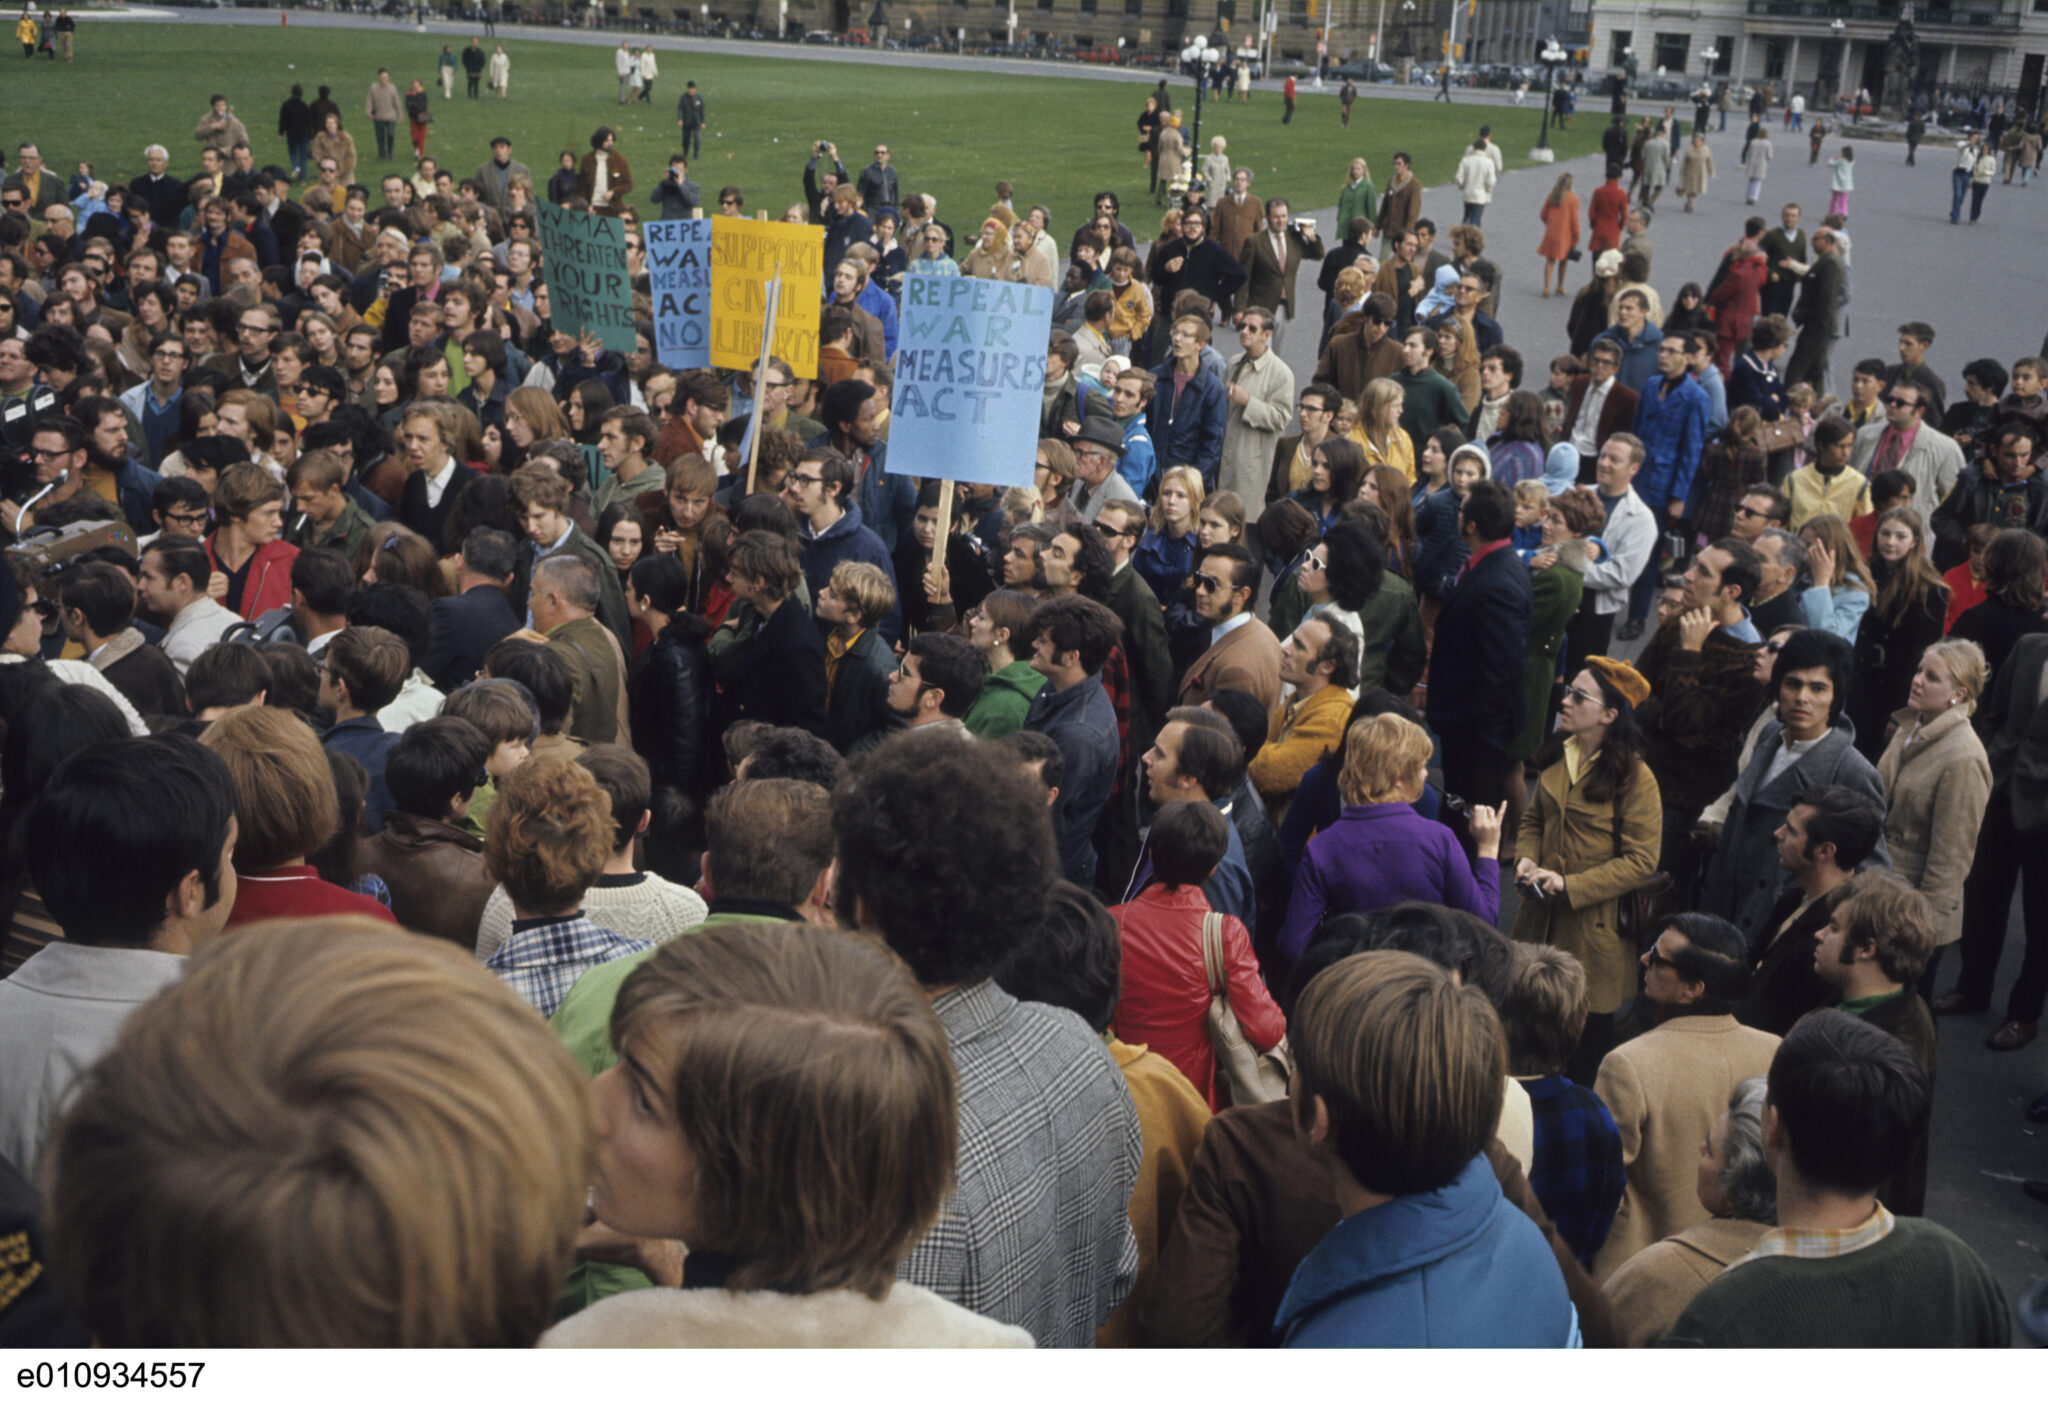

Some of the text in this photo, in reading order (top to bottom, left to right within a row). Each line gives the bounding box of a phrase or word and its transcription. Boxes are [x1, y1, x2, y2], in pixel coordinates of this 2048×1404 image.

[536, 202, 615, 241] WMA
[649, 221, 711, 243] REPE
[541, 224, 627, 269] THREATEN
[712, 231, 822, 277] SUPPORT
[549, 256, 622, 299] YOUR
[908, 278, 1044, 316] REPEAL
[555, 286, 635, 328] RIGHTS
[659, 293, 709, 317] AC
[659, 320, 703, 347] NO
[715, 317, 819, 364] LIBRTY
[905, 310, 1012, 347] WAR
[897, 349, 1046, 392] MEASURES
[893, 384, 1002, 425] ACT
